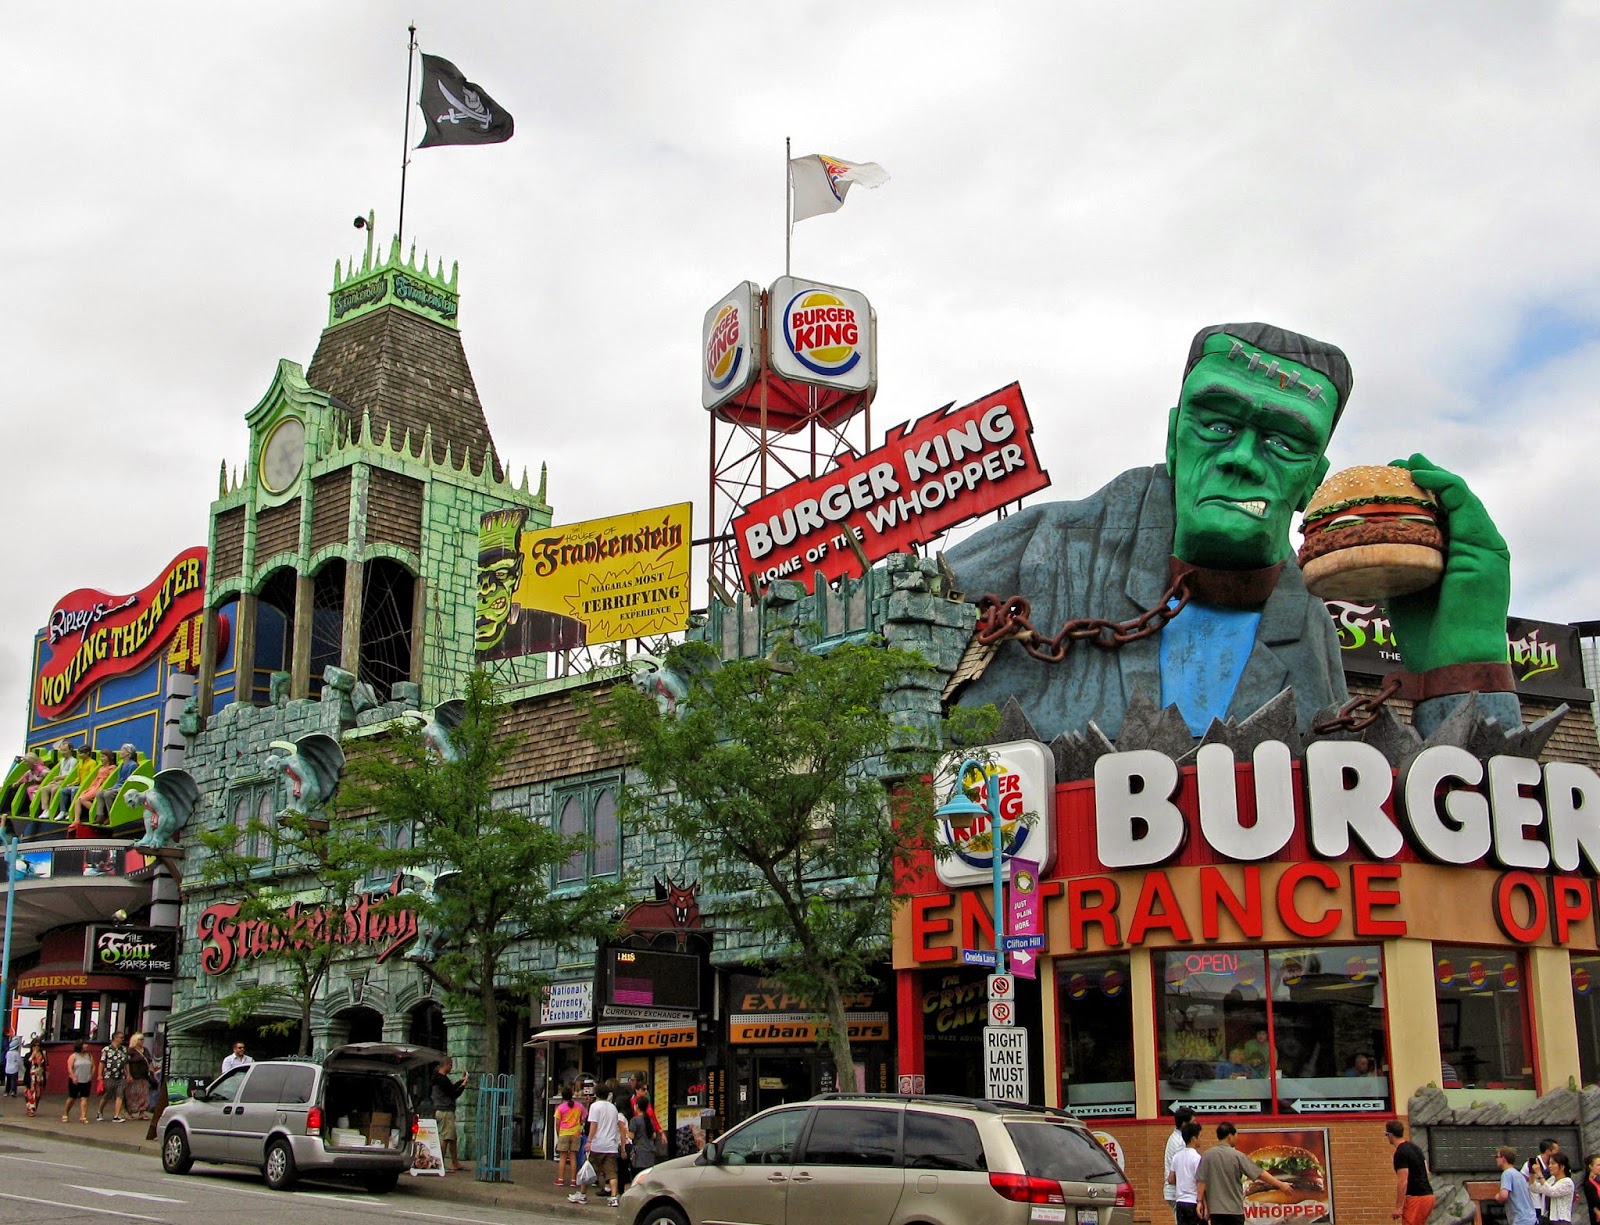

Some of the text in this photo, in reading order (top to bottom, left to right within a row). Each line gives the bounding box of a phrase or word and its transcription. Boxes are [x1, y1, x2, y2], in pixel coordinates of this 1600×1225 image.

[792, 307, 855, 329] BURGER
[795, 322, 858, 351] KING
[706, 321, 739, 376] KING
[745, 404, 1015, 559] BURGER KING
[757, 443, 1026, 585] HOME OF THE WHOPPER
[566, 526, 617, 543] HOUSE OF
[532, 514, 683, 576] Frankenstein
[591, 572, 664, 593] NIAGARAS MOST
[582, 586, 680, 614] TERRIFYING
[619, 605, 672, 621] EXPERIENCE
[40, 557, 201, 706] MOVING THEATER
[1379, 651, 1402, 661] THE
[1093, 739, 1600, 874] BURGER
[1014, 899, 1027, 909] JUST
[911, 863, 1600, 962] ENTRANCE OP
[1016, 909, 1032, 919] PLAIN
[1014, 920, 1030, 931] MORE
[98, 932, 157, 964] Fear
[1006, 937, 1041, 949] Clifton Hill
[965, 952, 996, 963] Oneida Lane
[1185, 954, 1238, 972] OPEN
[148, 961, 172, 970] HERE
[21, 976, 88, 989] EXPERIENCE
[552, 984, 582, 996] National
[551, 998, 582, 1008] Currency
[922, 980, 987, 1013] CRYST
[550, 1010, 582, 1020] Exchange
[605, 1008, 681, 1019] CURRENCY EXCHANGE
[936, 1003, 988, 1032] CAVE
[601, 1030, 694, 1047] cuban cigars
[742, 1025, 808, 1039] cuban
[988, 1033, 1024, 1047] RIGHT
[990, 1050, 1022, 1065] LANE
[989, 1067, 1024, 1081] MUST
[688, 1083, 707, 1095] OPE
[989, 1084, 1023, 1099] TURN
[1070, 1105, 1134, 1114] ENTRANCE
[1179, 1102, 1258, 1112] ENTRANCE
[1301, 1102, 1381, 1110] ENTRANCE
[1244, 1204, 1325, 1219] WHOPPER
